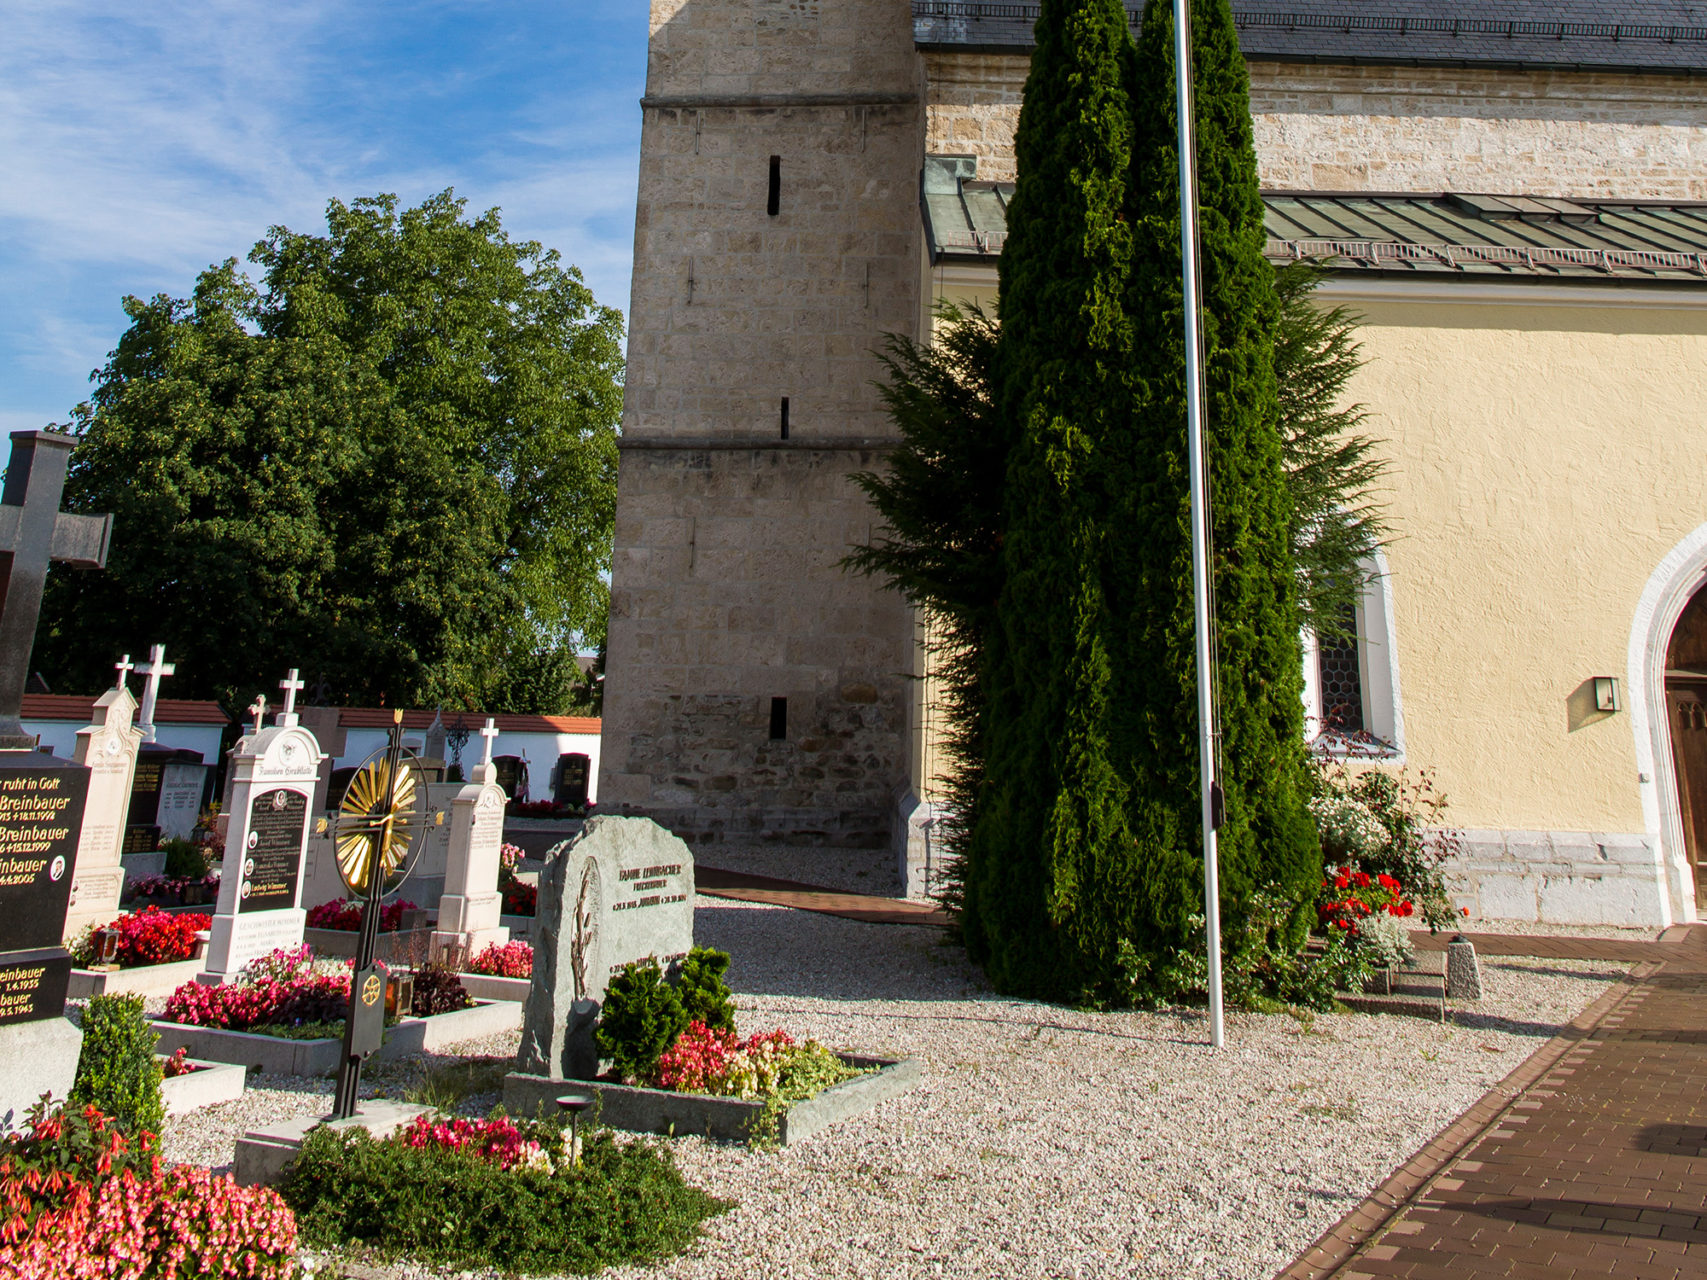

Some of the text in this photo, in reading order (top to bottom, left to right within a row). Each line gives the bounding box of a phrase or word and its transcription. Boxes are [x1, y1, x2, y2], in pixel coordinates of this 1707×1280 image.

[3, 776, 61, 791] ruht in Gott
[0, 794, 71, 811] Breinbauer
[0, 825, 69, 841] Breinbauer
